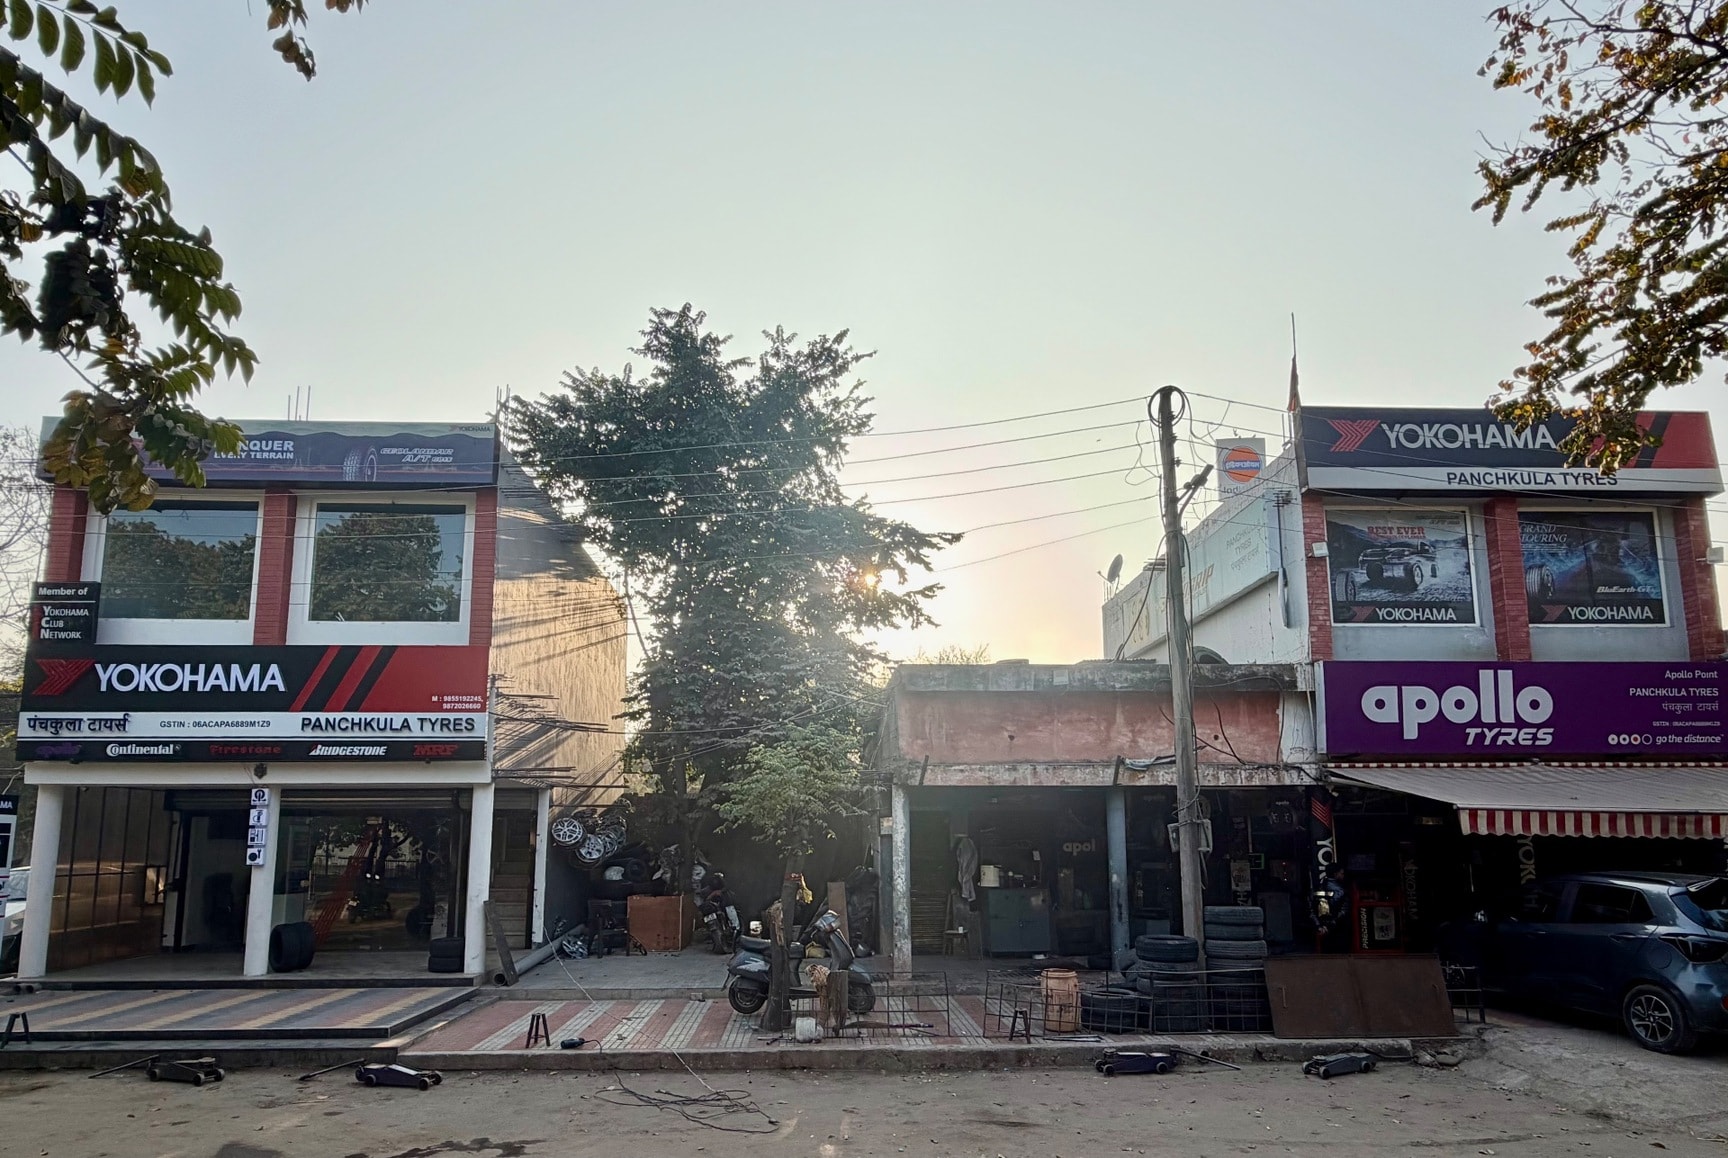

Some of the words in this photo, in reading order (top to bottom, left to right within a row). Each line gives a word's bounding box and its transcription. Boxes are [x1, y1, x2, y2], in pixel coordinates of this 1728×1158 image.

[1381, 423, 1557, 449] YOKOHAMA
[250, 451, 294, 459] TERRAIN
[1447, 472, 1556, 485] PANCHKULA
[1559, 473, 1618, 485] TYRES
[1397, 526, 1425, 534] EVER
[1519, 523, 1557, 533] GRAND
[1520, 534, 1568, 542] TOURING
[38, 587, 76, 595] Member
[77, 587, 88, 595] of
[43, 605, 89, 616] YOKOHAMA
[1376, 607, 1457, 620] YOKOHAMA
[1567, 606, 1654, 620] YOKOHAMA
[41, 617, 64, 628] CLUB
[40, 628, 82, 639] NETWORK
[94, 663, 286, 692] YOKOHAMA
[1665, 670, 1693, 680] Apollo
[1694, 670, 1718, 679] Point
[1629, 687, 1688, 697] PANCHKULA
[1688, 687, 1719, 697] TYRES
[1361, 669, 1554, 740] apollo
[1662, 700, 1693, 715] पंचकुला
[1696, 700, 1719, 712] टायर्स
[27, 715, 83, 735] पंचकुला
[86, 712, 130, 732] टायर्स
[160, 720, 185, 728] GSTIN
[301, 717, 412, 732] PANCHKULA
[416, 717, 476, 732] TYRES
[1465, 727, 1554, 746] TYRES
[1655, 736, 1667, 745] go
[1668, 734, 1683, 743] the
[1684, 734, 1722, 743] distance
[106, 744, 174, 756] Continental
[210, 744, 281, 755] Firestone
[309, 745, 388, 756] BRIDGESTONE
[414, 744, 459, 756] MRF
